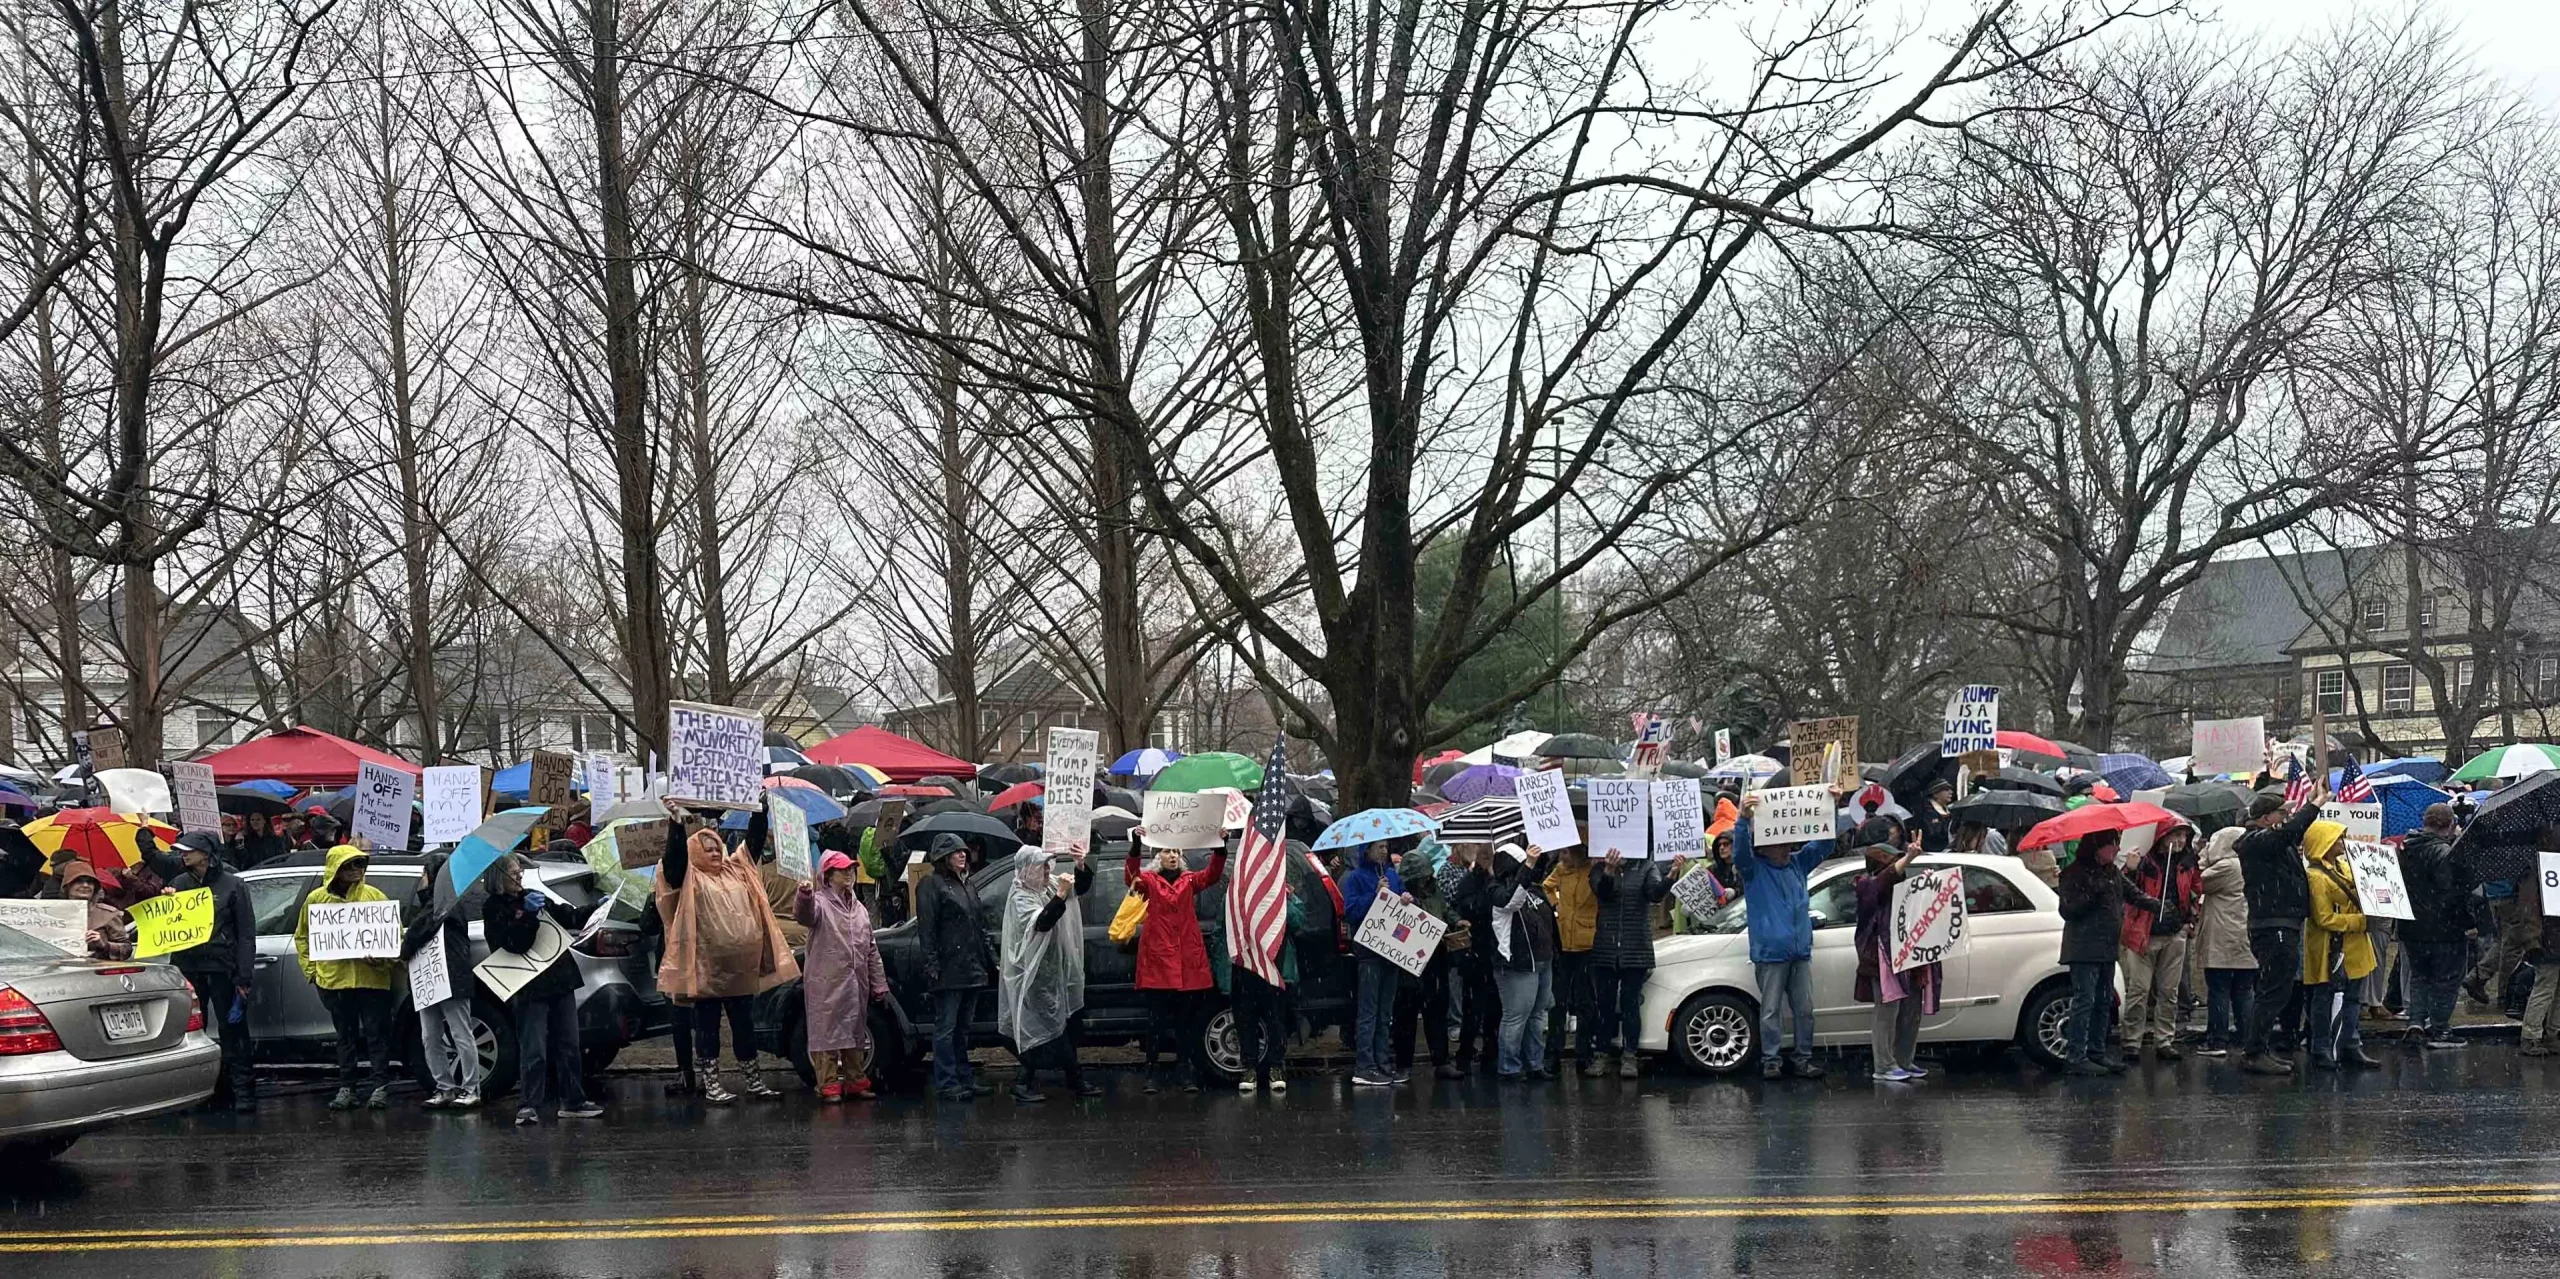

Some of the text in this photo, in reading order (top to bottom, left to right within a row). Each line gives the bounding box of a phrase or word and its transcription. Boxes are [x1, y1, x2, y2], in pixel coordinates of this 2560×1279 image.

[1959, 704, 1988, 718] IS A
[674, 710, 755, 736] THE ONLY
[1798, 718, 1854, 733] THE ONLY
[1945, 719, 1993, 735] LYING
[683, 728, 760, 758] MINORITY
[1797, 729, 1854, 742] MINORITY
[1943, 737, 1995, 754] MORON
[536, 755, 573, 777] HANDS
[682, 746, 761, 776] DESTROYING
[174, 764, 211, 780] DICTATOR
[365, 766, 400, 786] HANDS
[431, 771, 480, 787] HANDS
[671, 765, 753, 790] AMERICA IS
[1842, 766, 1854, 776] HE
[177, 781, 193, 794] NOT
[541, 772, 565, 788] OFF
[1519, 771, 1554, 793] ARREST
[1665, 780, 1689, 793] FREE
[373, 782, 402, 799] OFF
[440, 787, 471, 800] OFF
[539, 786, 565, 804] OUR
[691, 782, 753, 803] THE 1%
[1047, 787, 1083, 805] DIES
[1524, 785, 1557, 805] TRUMP
[1596, 781, 1636, 796] LOCK
[1764, 789, 1824, 804] IMPEACH
[185, 798, 209, 809] DICK
[1155, 795, 1200, 810] HANDS
[1529, 800, 1559, 818] MUSK
[1591, 797, 1640, 813] TRUMP
[1656, 792, 1697, 810] SPEECH
[182, 811, 220, 827] TRAITOR
[1169, 811, 1190, 820] OFF
[1226, 801, 1247, 822] OFF
[1664, 807, 1700, 821] PROTECT
[1773, 807, 1821, 819] REGIME
[2319, 809, 2380, 820] EEP YOUR
[1149, 823, 1174, 834] OUR
[1537, 814, 1560, 831] NOW
[1605, 814, 1628, 829] UP
[1674, 820, 1695, 830] OUR
[1764, 822, 1830, 837] SAVE USA
[1667, 827, 1695, 839] FIRST
[1656, 837, 1705, 854] AMENDMENT
[141, 890, 209, 920] HANDS OFF
[1897, 904, 1908, 943] STOP
[1910, 875, 1942, 894] SCAM
[166, 913, 189, 925] OUR
[310, 904, 400, 926] MAKE AMERICA
[1381, 896, 1441, 941] HANDS OFF
[1893, 868, 1963, 971] SAVE DEMOCRACY
[1, 918, 67, 929] LIGARCHS
[1365, 918, 1387, 931] OUR
[1911, 945, 1942, 963] STOP
[1948, 893, 1963, 940] COUP
[310, 926, 399, 952] THINK AGAIN!
[426, 935, 446, 985] RANGE
[411, 967, 430, 1007] THIS?
[420, 960, 435, 1000] TIRED
